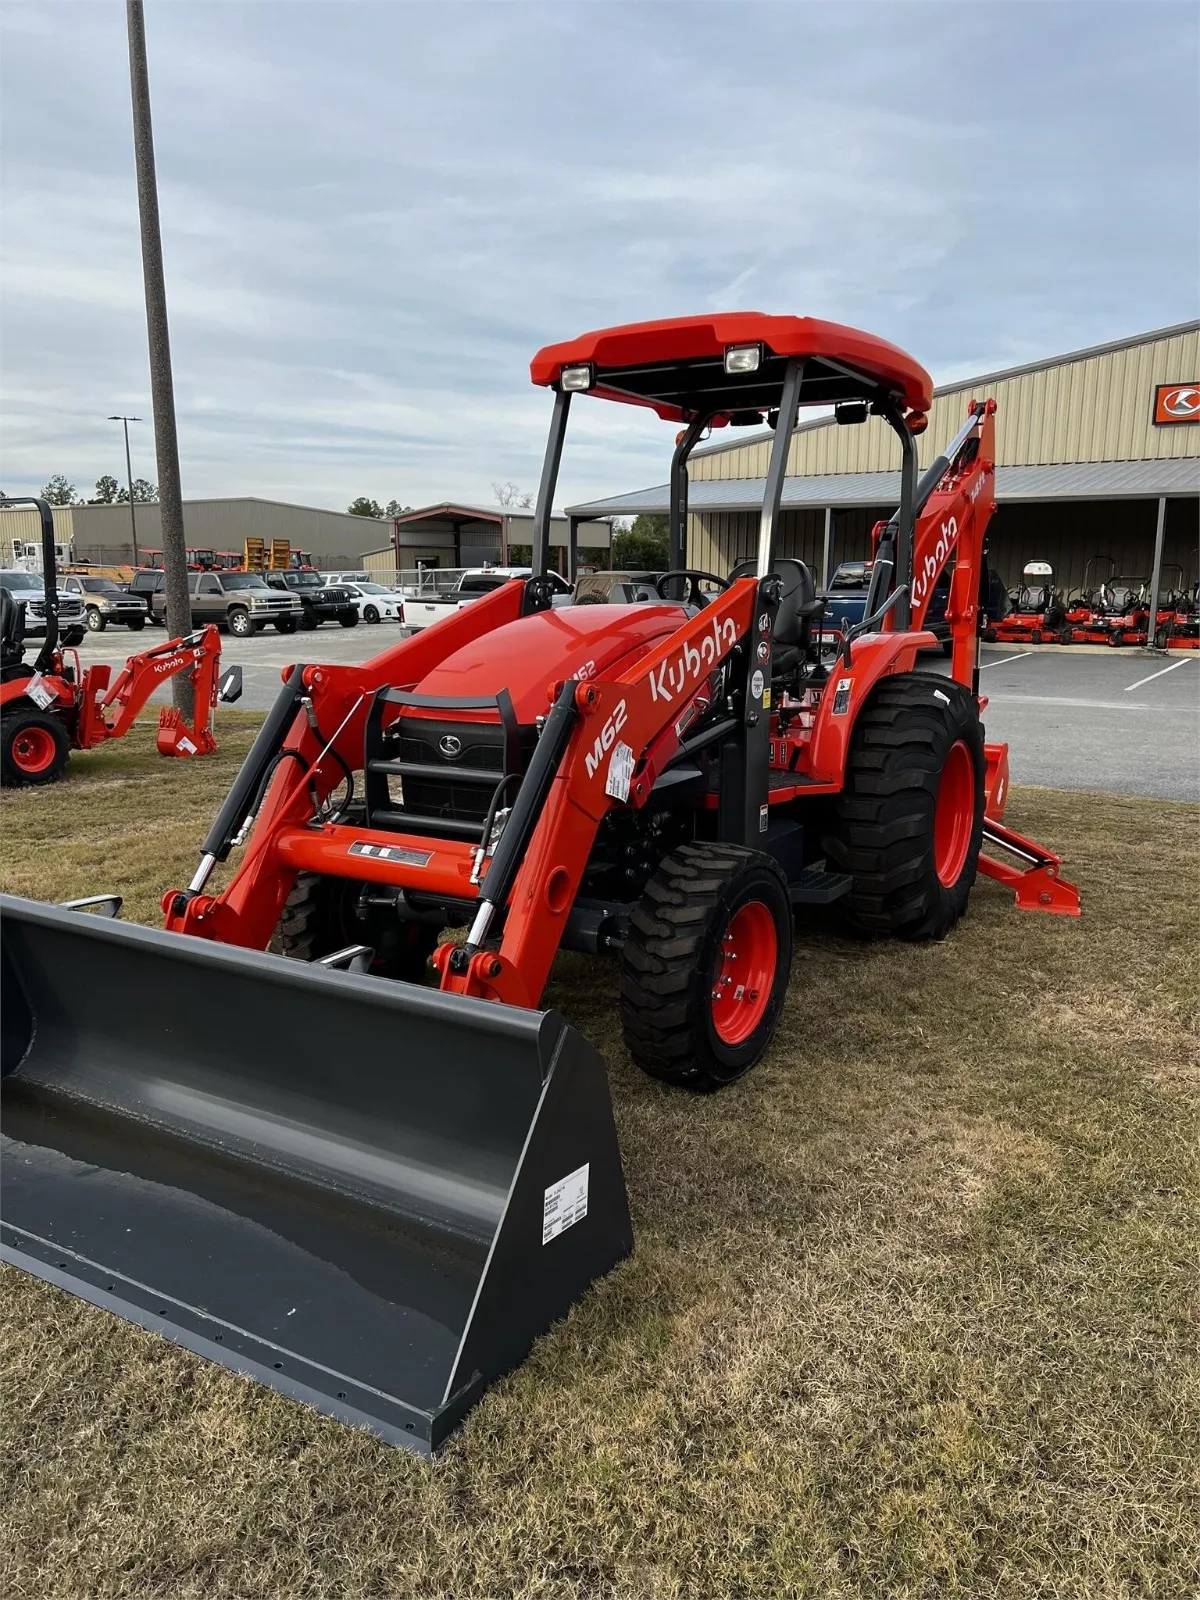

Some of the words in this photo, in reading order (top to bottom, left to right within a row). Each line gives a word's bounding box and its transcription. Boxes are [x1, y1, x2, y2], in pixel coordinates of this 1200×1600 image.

[153, 658, 184, 673] Kubota
[648, 616, 738, 703] Kubota
[584, 698, 628, 780] M62
